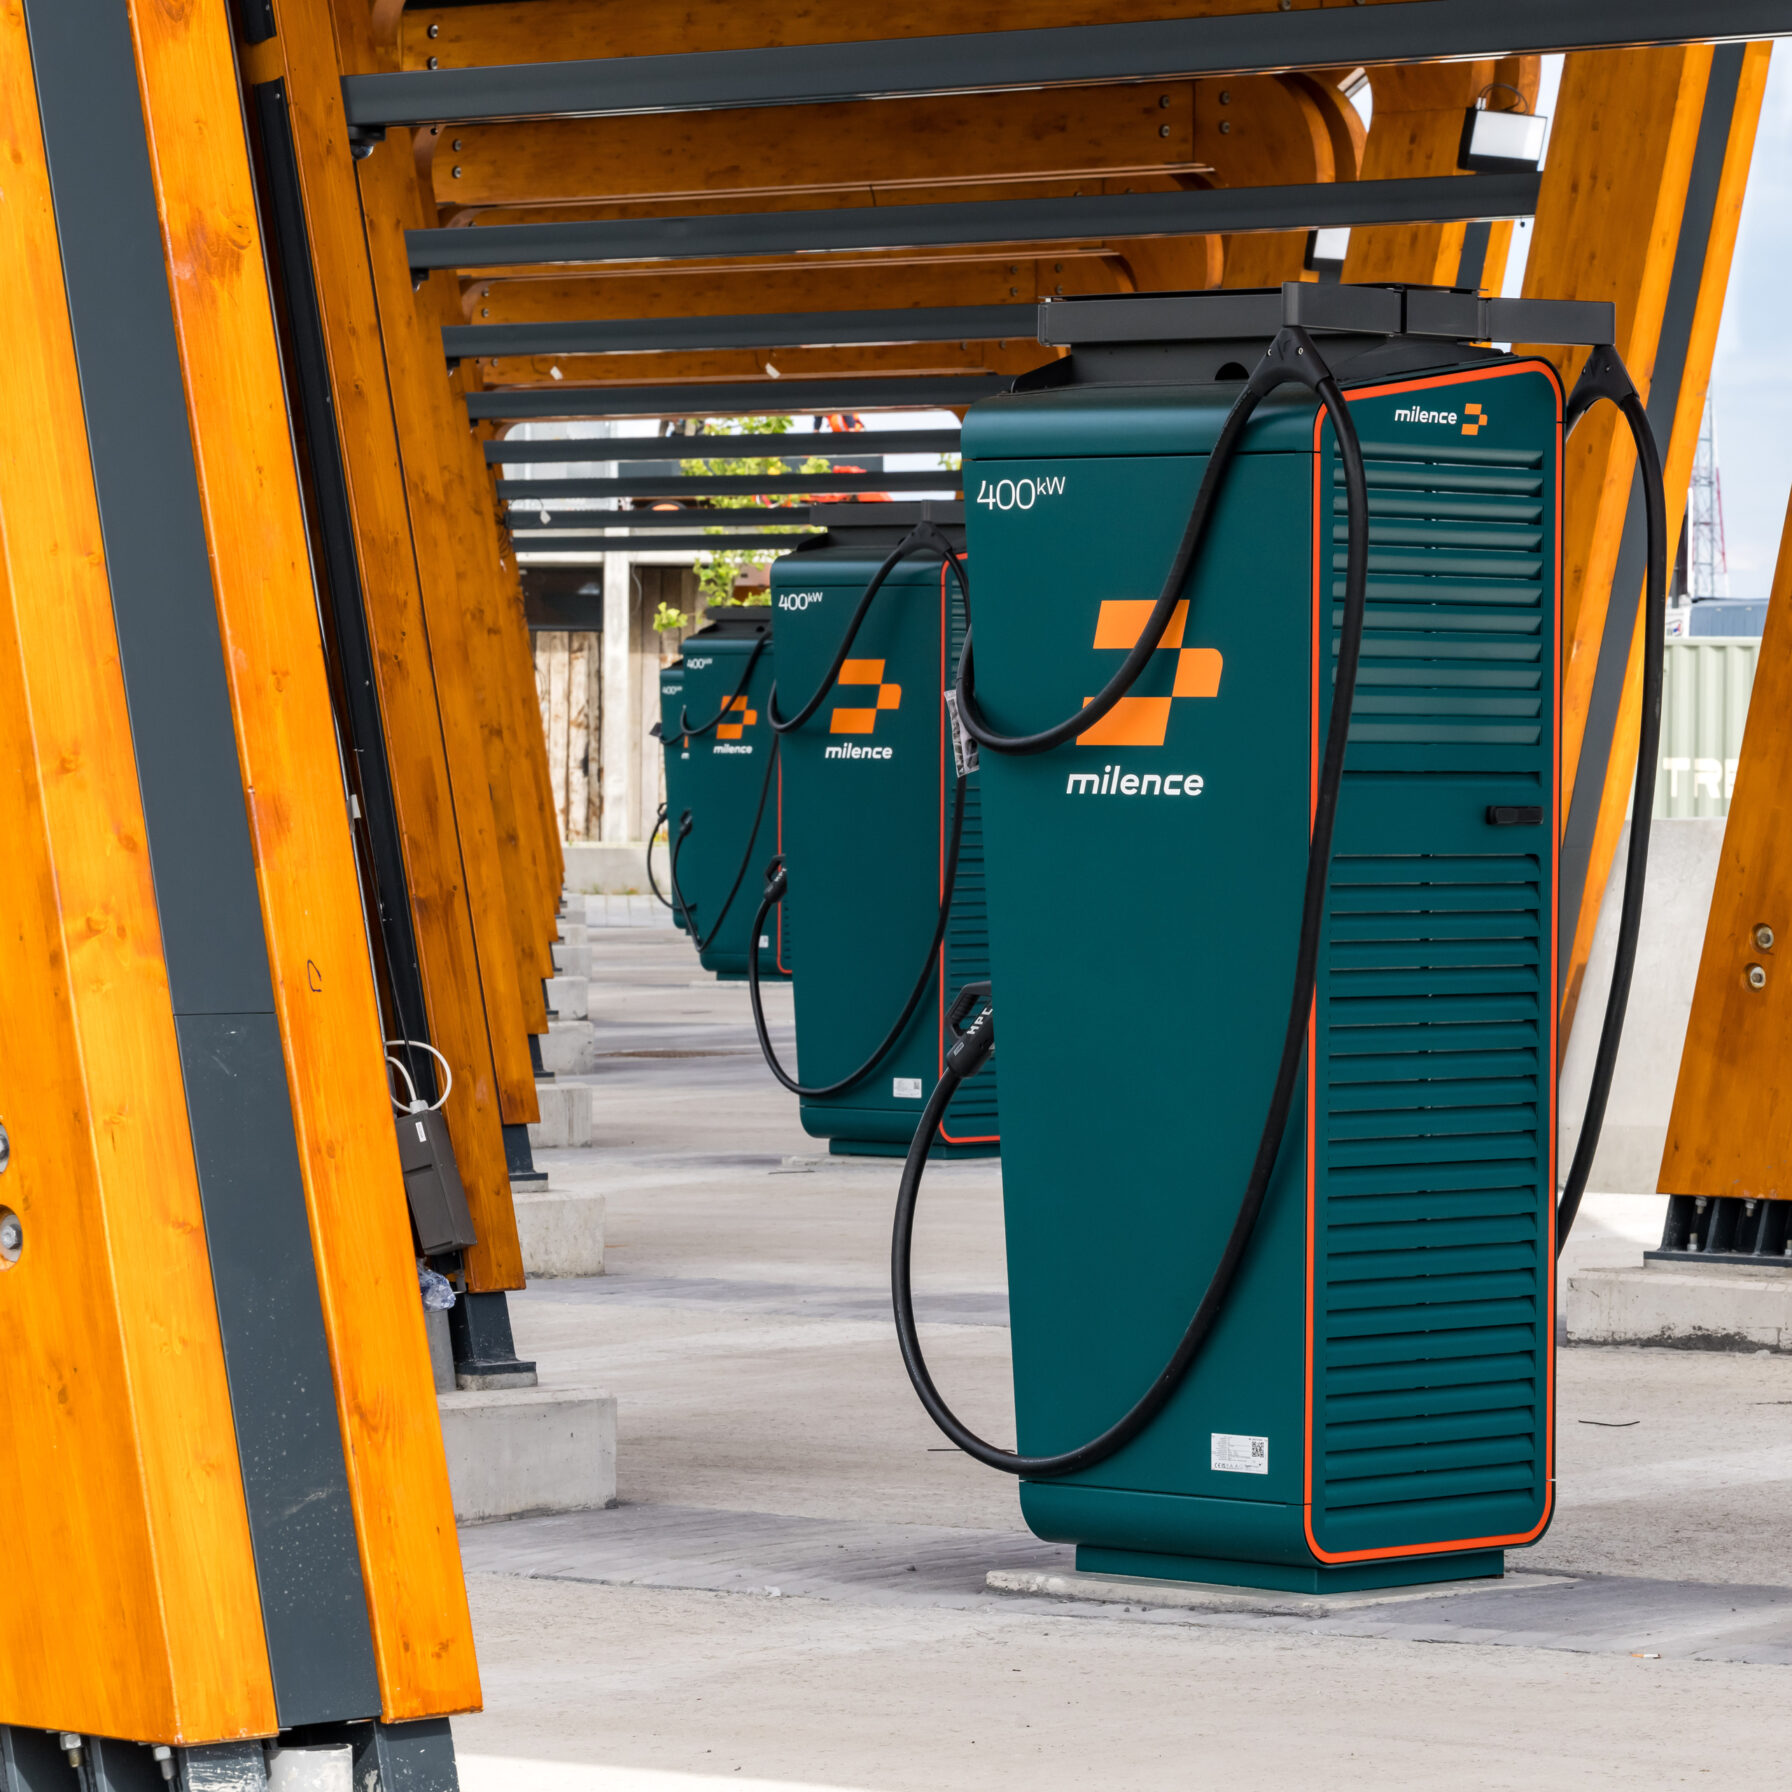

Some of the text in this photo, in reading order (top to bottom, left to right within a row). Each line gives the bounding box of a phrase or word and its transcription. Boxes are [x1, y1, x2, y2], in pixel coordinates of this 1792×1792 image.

[1394, 405, 1458, 425] milence
[976, 476, 1066, 511] 400kW
[778, 591, 823, 611] 400kW
[661, 685, 683, 695] 400
[712, 743, 753, 754] milence
[824, 742, 893, 760] milence
[1065, 764, 1204, 797] milence
